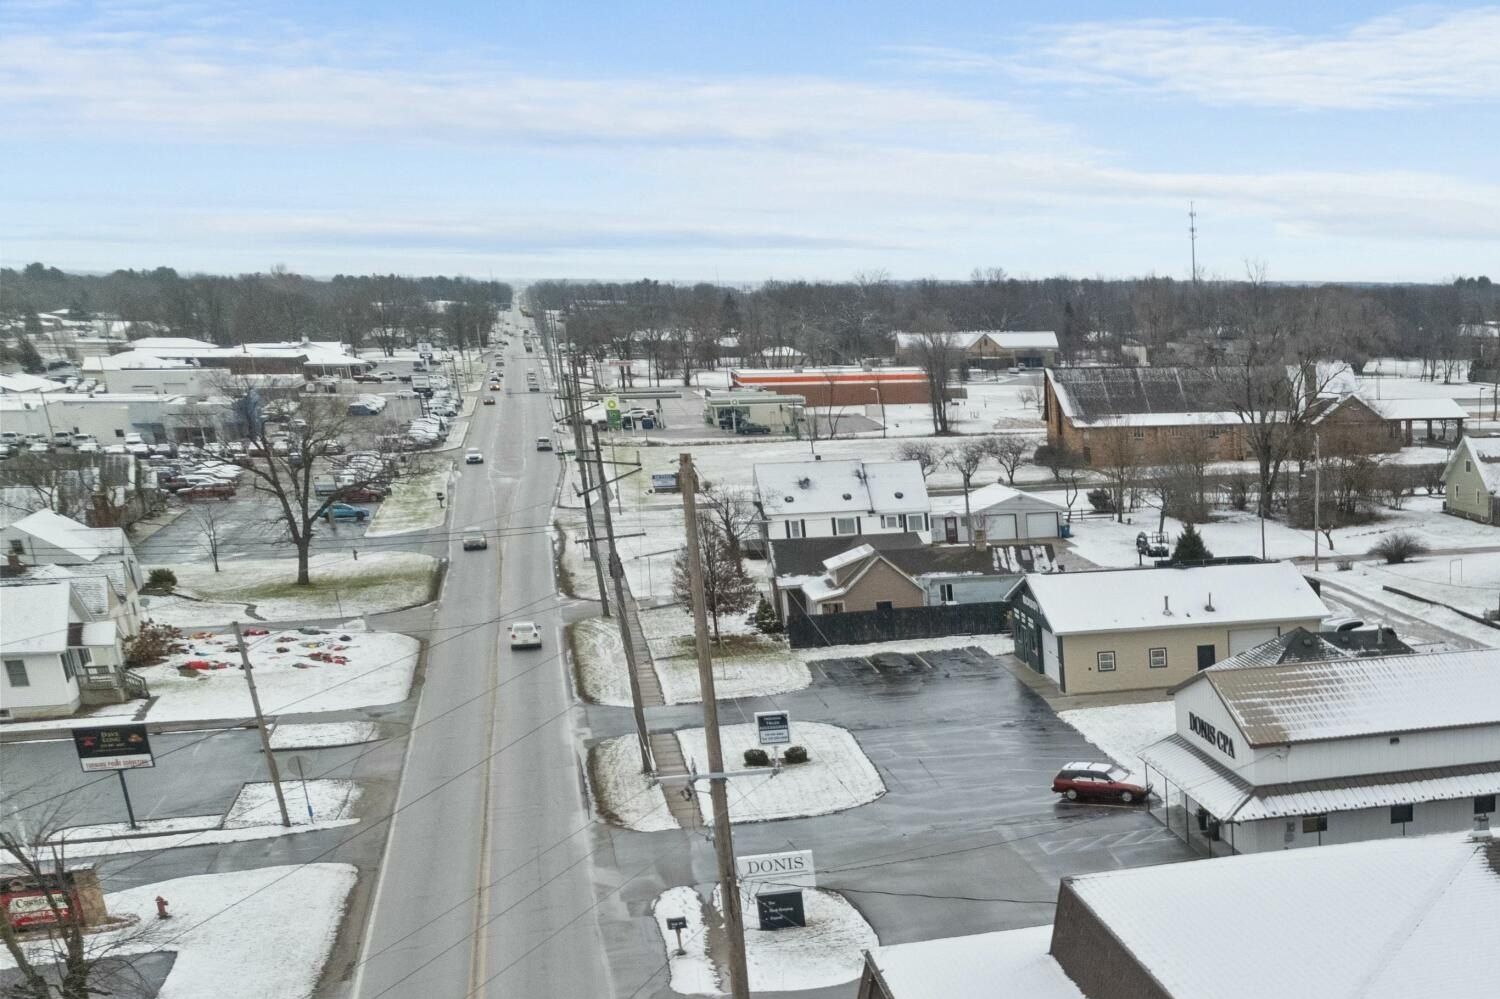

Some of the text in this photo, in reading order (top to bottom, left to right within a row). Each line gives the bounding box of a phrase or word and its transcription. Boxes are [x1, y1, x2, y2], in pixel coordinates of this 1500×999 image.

[1189, 711, 1235, 759] DONIS CPA
[747, 856, 804, 874] DONIS
